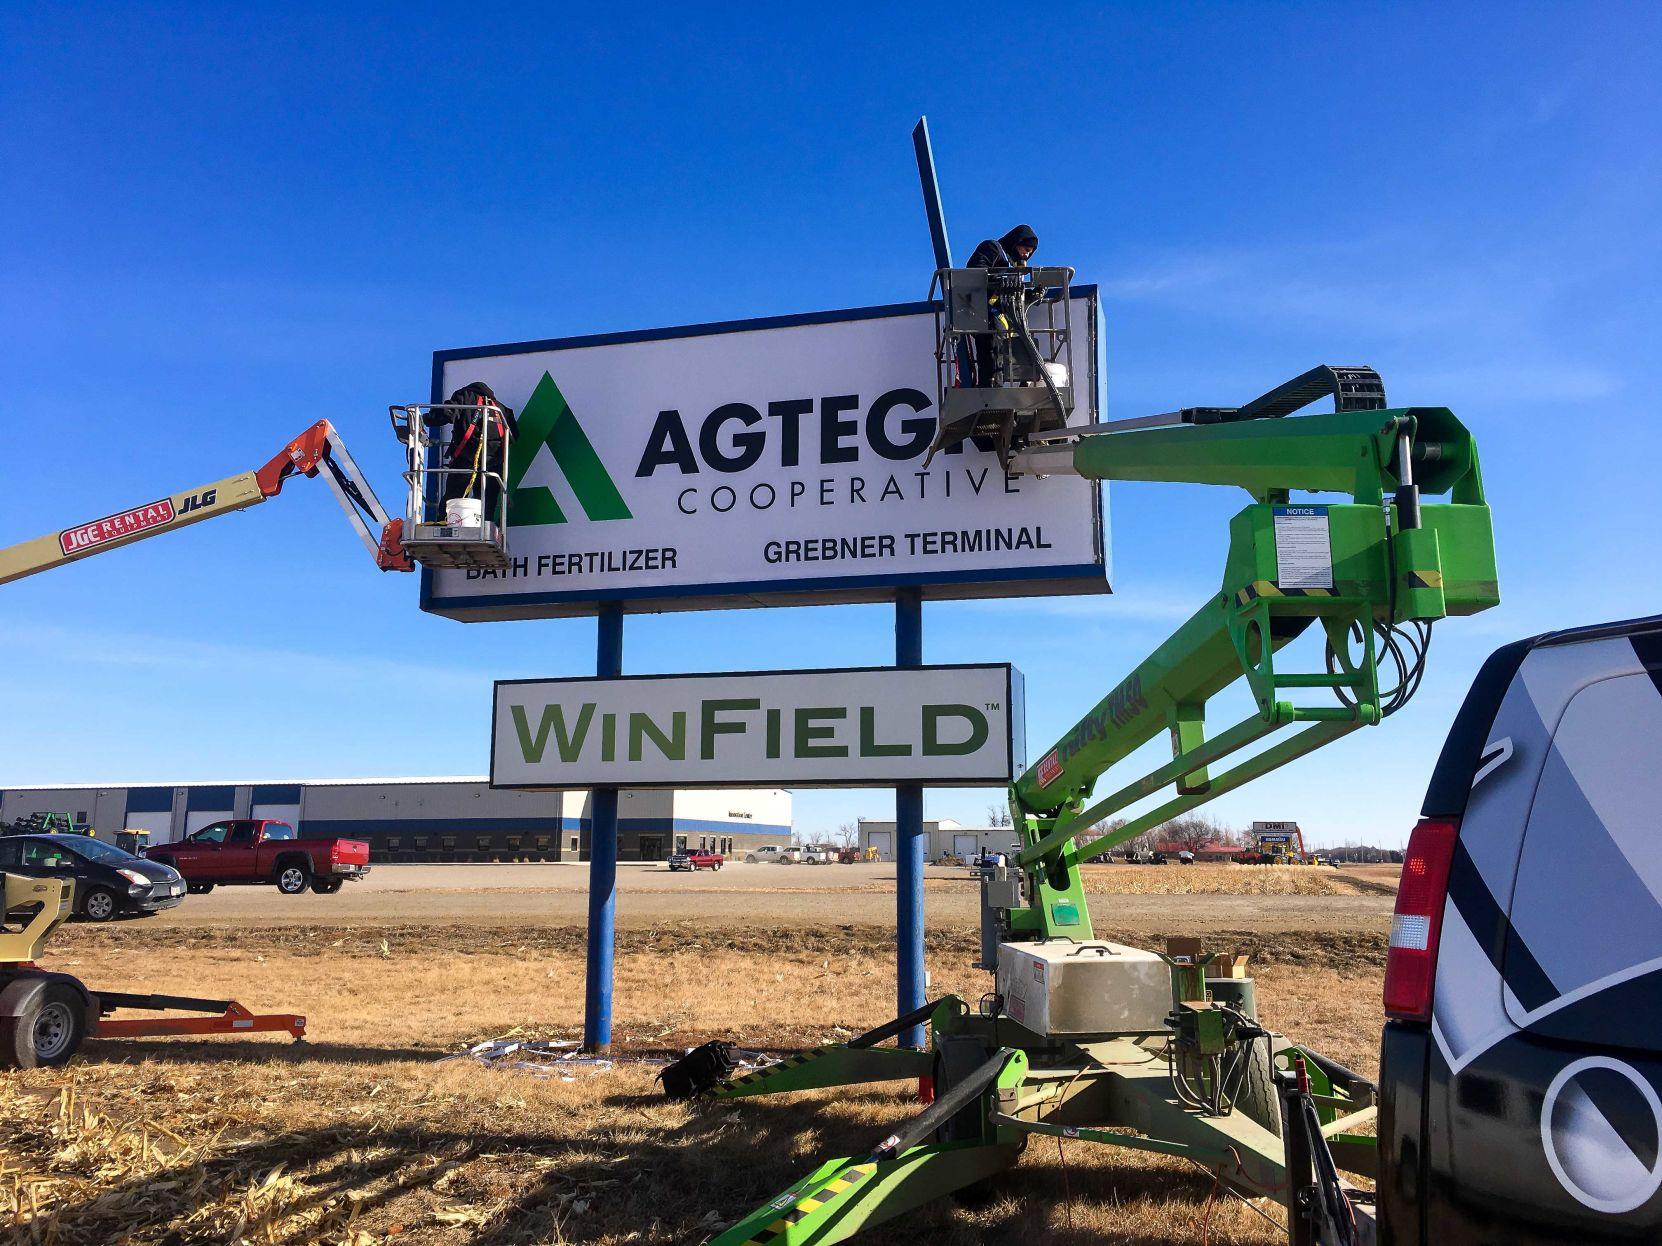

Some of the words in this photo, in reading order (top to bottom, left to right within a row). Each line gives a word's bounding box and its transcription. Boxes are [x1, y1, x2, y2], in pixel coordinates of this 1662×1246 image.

[635, 388, 998, 477] AGTEG
[178, 489, 217, 515] JLG
[677, 467, 1020, 515] COOPERATIVE
[68, 526, 101, 549] JGE
[102, 505, 167, 533] RENTAL
[764, 535, 896, 565] GREBNER
[904, 526, 1052, 556] TERMINAL
[537, 547, 677, 576] FERTILIZER
